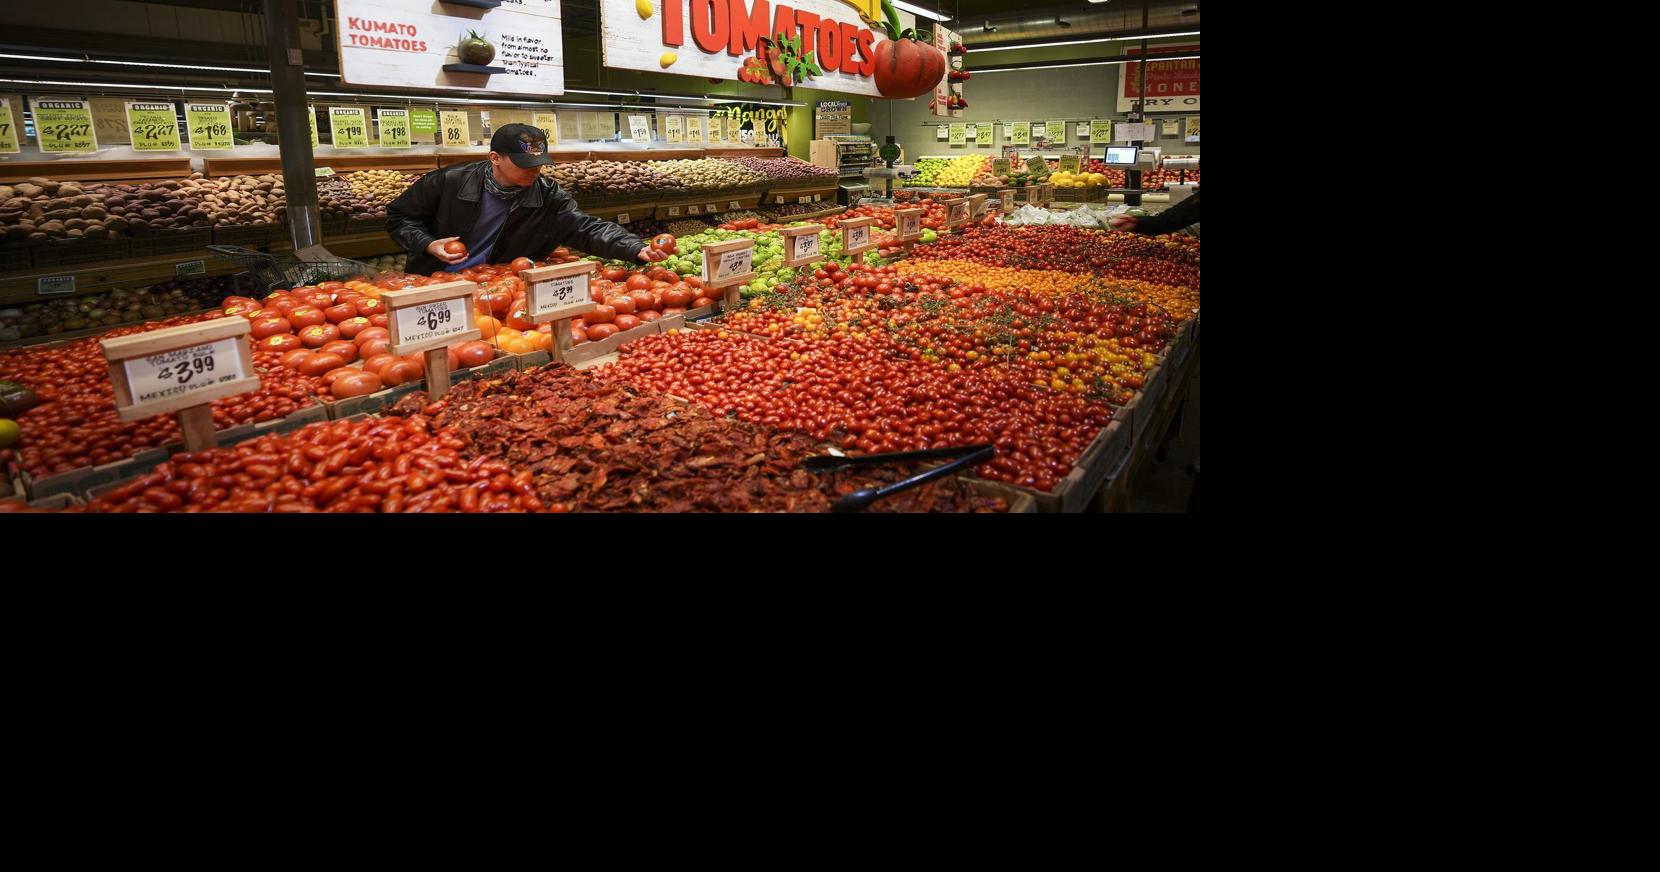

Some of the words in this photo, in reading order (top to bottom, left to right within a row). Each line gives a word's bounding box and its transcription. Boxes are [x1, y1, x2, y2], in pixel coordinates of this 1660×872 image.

[348, 16, 417, 37] KUMATO
[349, 34, 428, 52] TOMATOES
[501, 33, 515, 42] Mild
[662, 0, 876, 78] TOMATOES
[501, 42, 516, 50] from
[517, 44, 538, 53] almost
[501, 50, 520, 59] flavor
[529, 54, 554, 62] sweeter
[518, 60, 538, 69] typical
[405, 332, 433, 342] MEXICO
[139, 384, 187, 401] MEXICO
